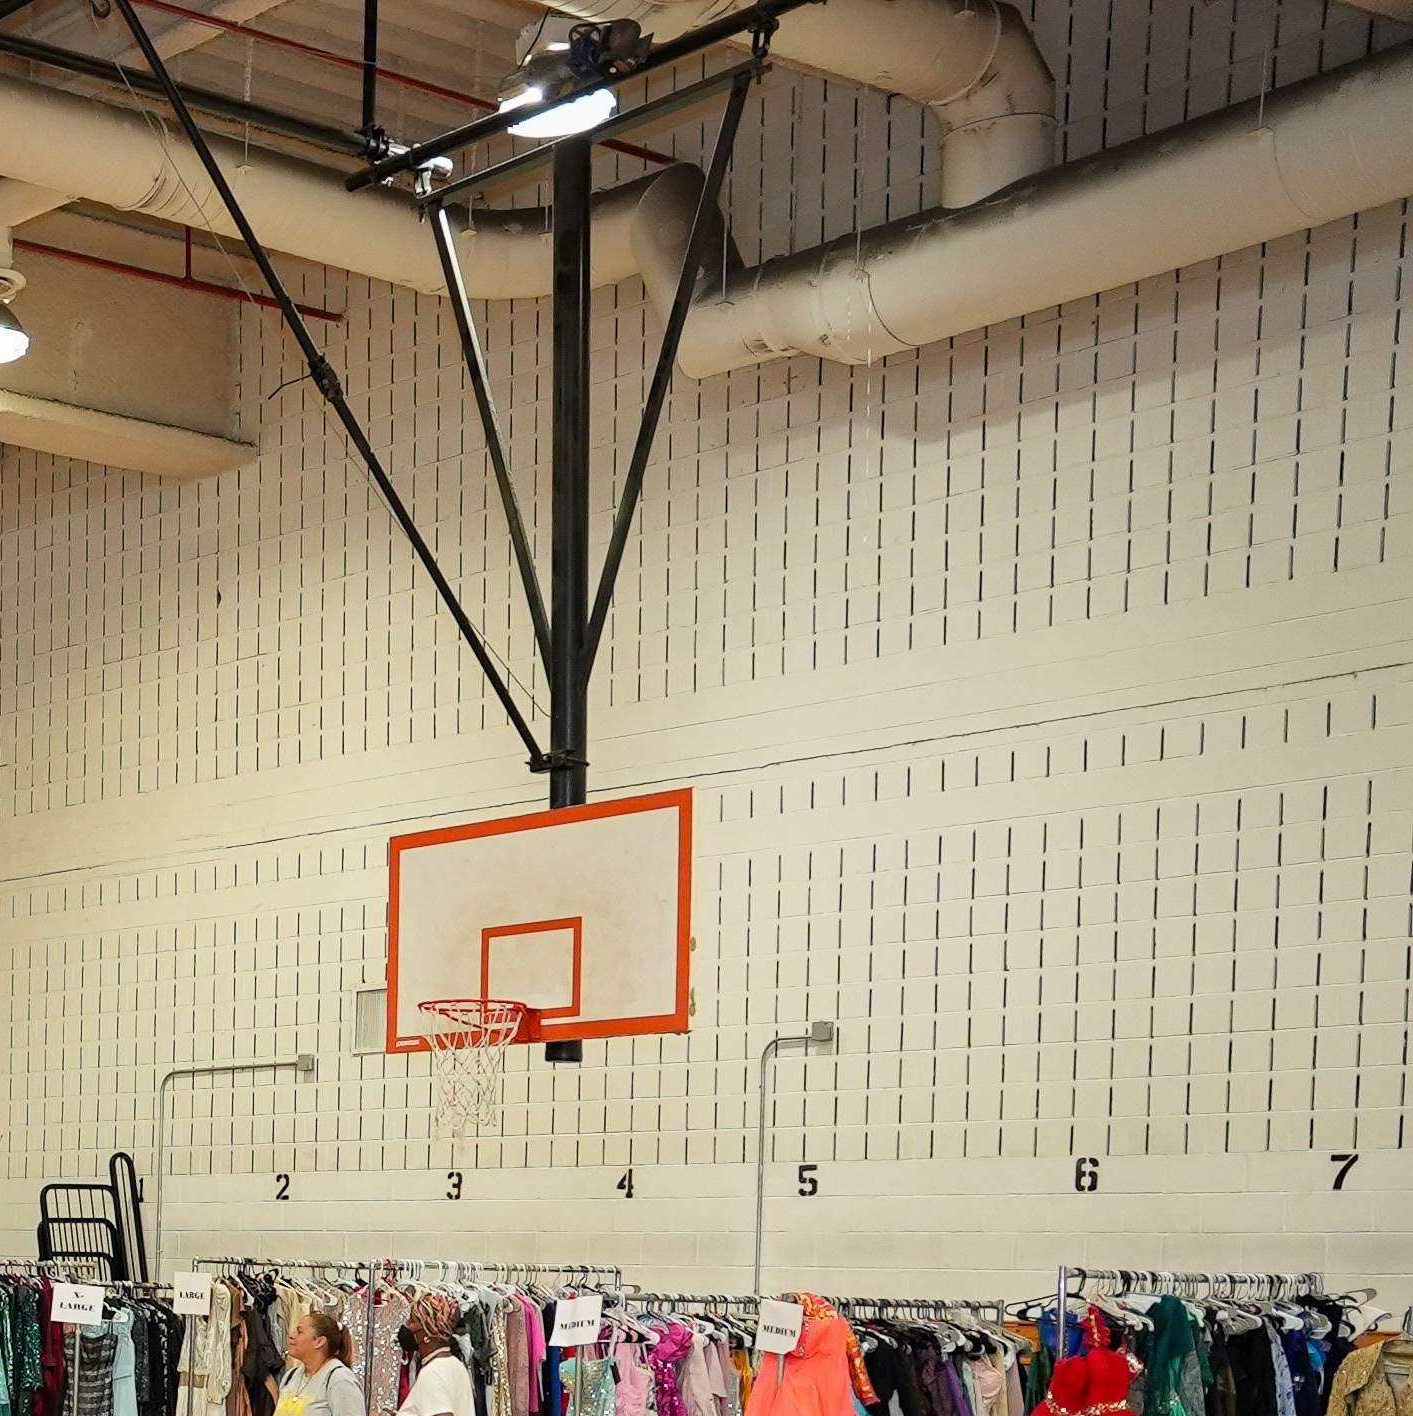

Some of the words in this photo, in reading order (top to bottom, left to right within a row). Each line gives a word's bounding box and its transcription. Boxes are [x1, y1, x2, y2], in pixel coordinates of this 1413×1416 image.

[446, 1171, 463, 1200] 3
[616, 1168, 634, 1198] 4
[797, 1163, 820, 1197] 5
[1074, 1156, 1100, 1193] 6
[1329, 1153, 1360, 1192] 7
[275, 1173, 291, 1201] 2
[60, 1301, 96, 1312] LARGE
[179, 1291, 205, 1300] LARGE
[560, 1319, 595, 1331] MEDIUM
[762, 1325, 797, 1338] MEDIUM
